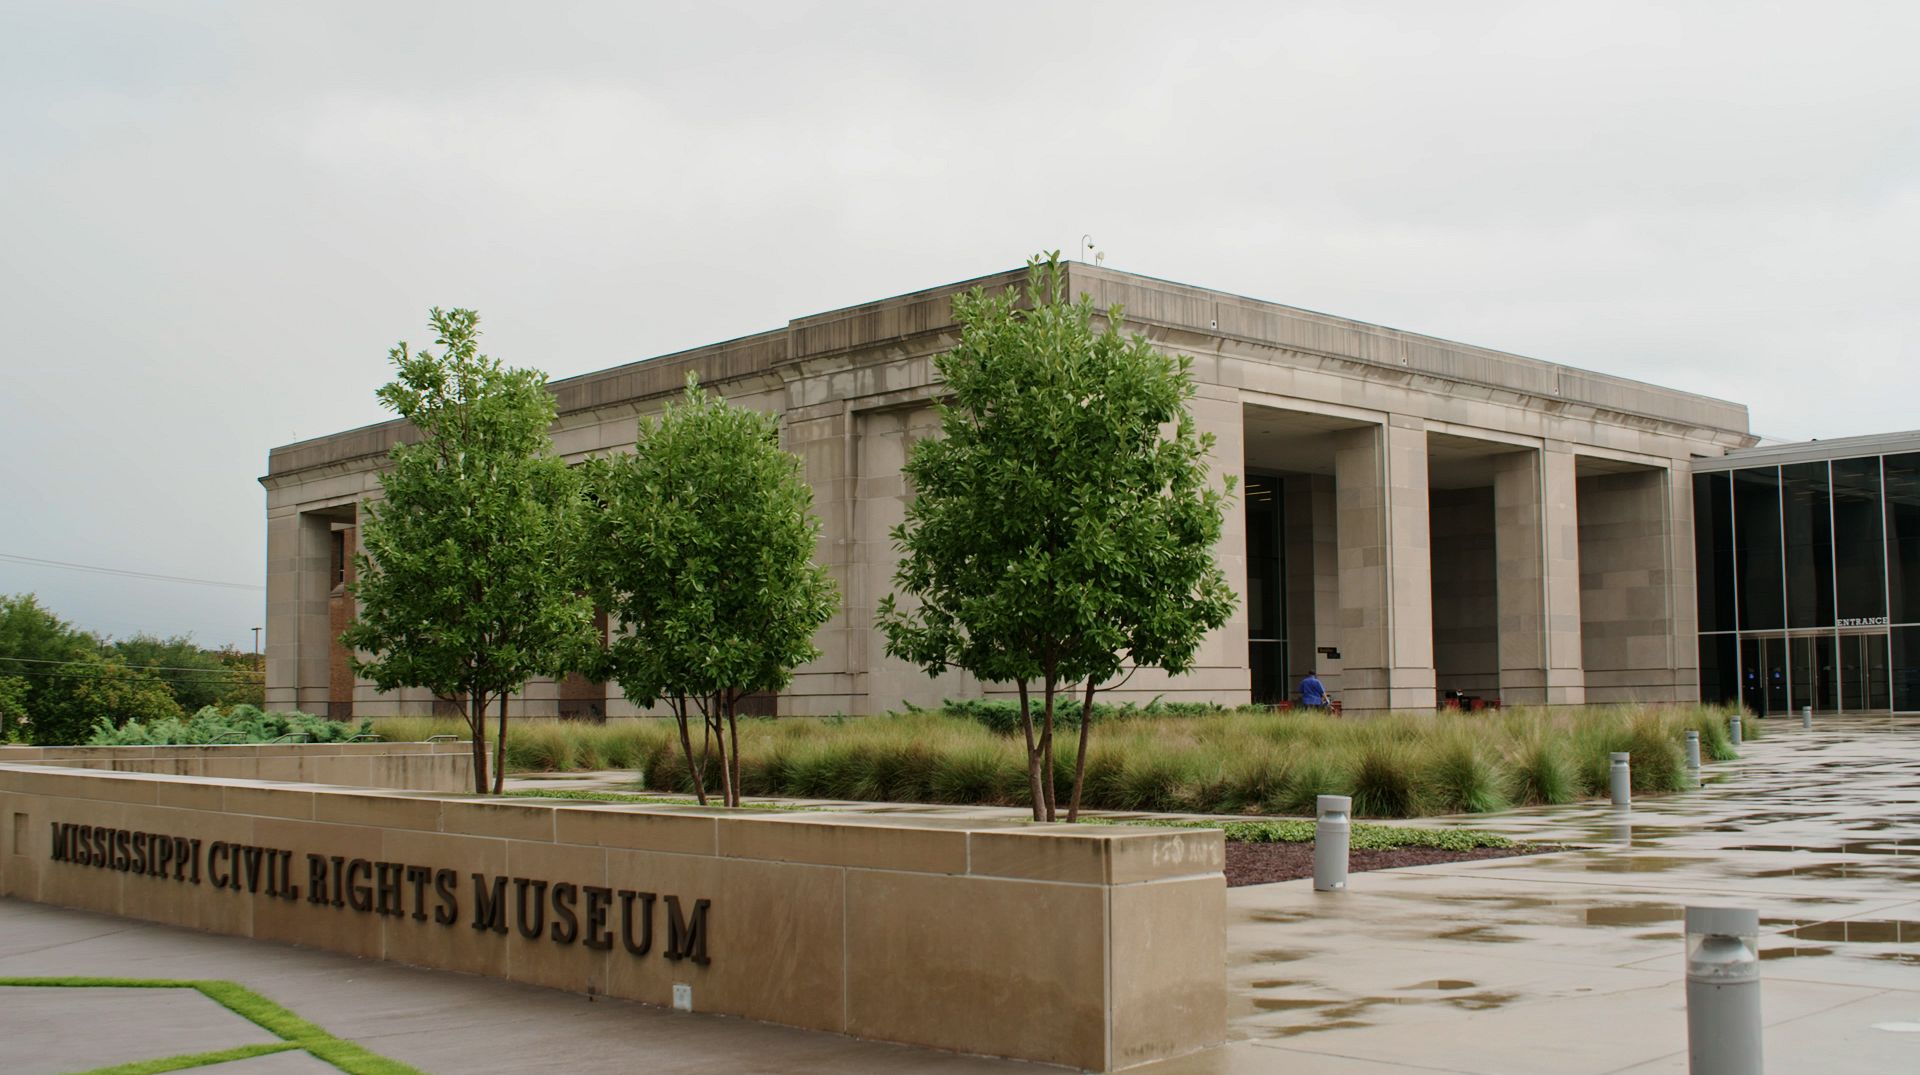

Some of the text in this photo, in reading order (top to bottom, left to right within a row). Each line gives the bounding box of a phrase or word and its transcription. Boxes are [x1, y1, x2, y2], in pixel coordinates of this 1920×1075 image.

[1837, 617, 1888, 626] ENTRANCE
[51, 822, 711, 966] MISSISSIPPI CIVIL RIGHTS MUSEUM
